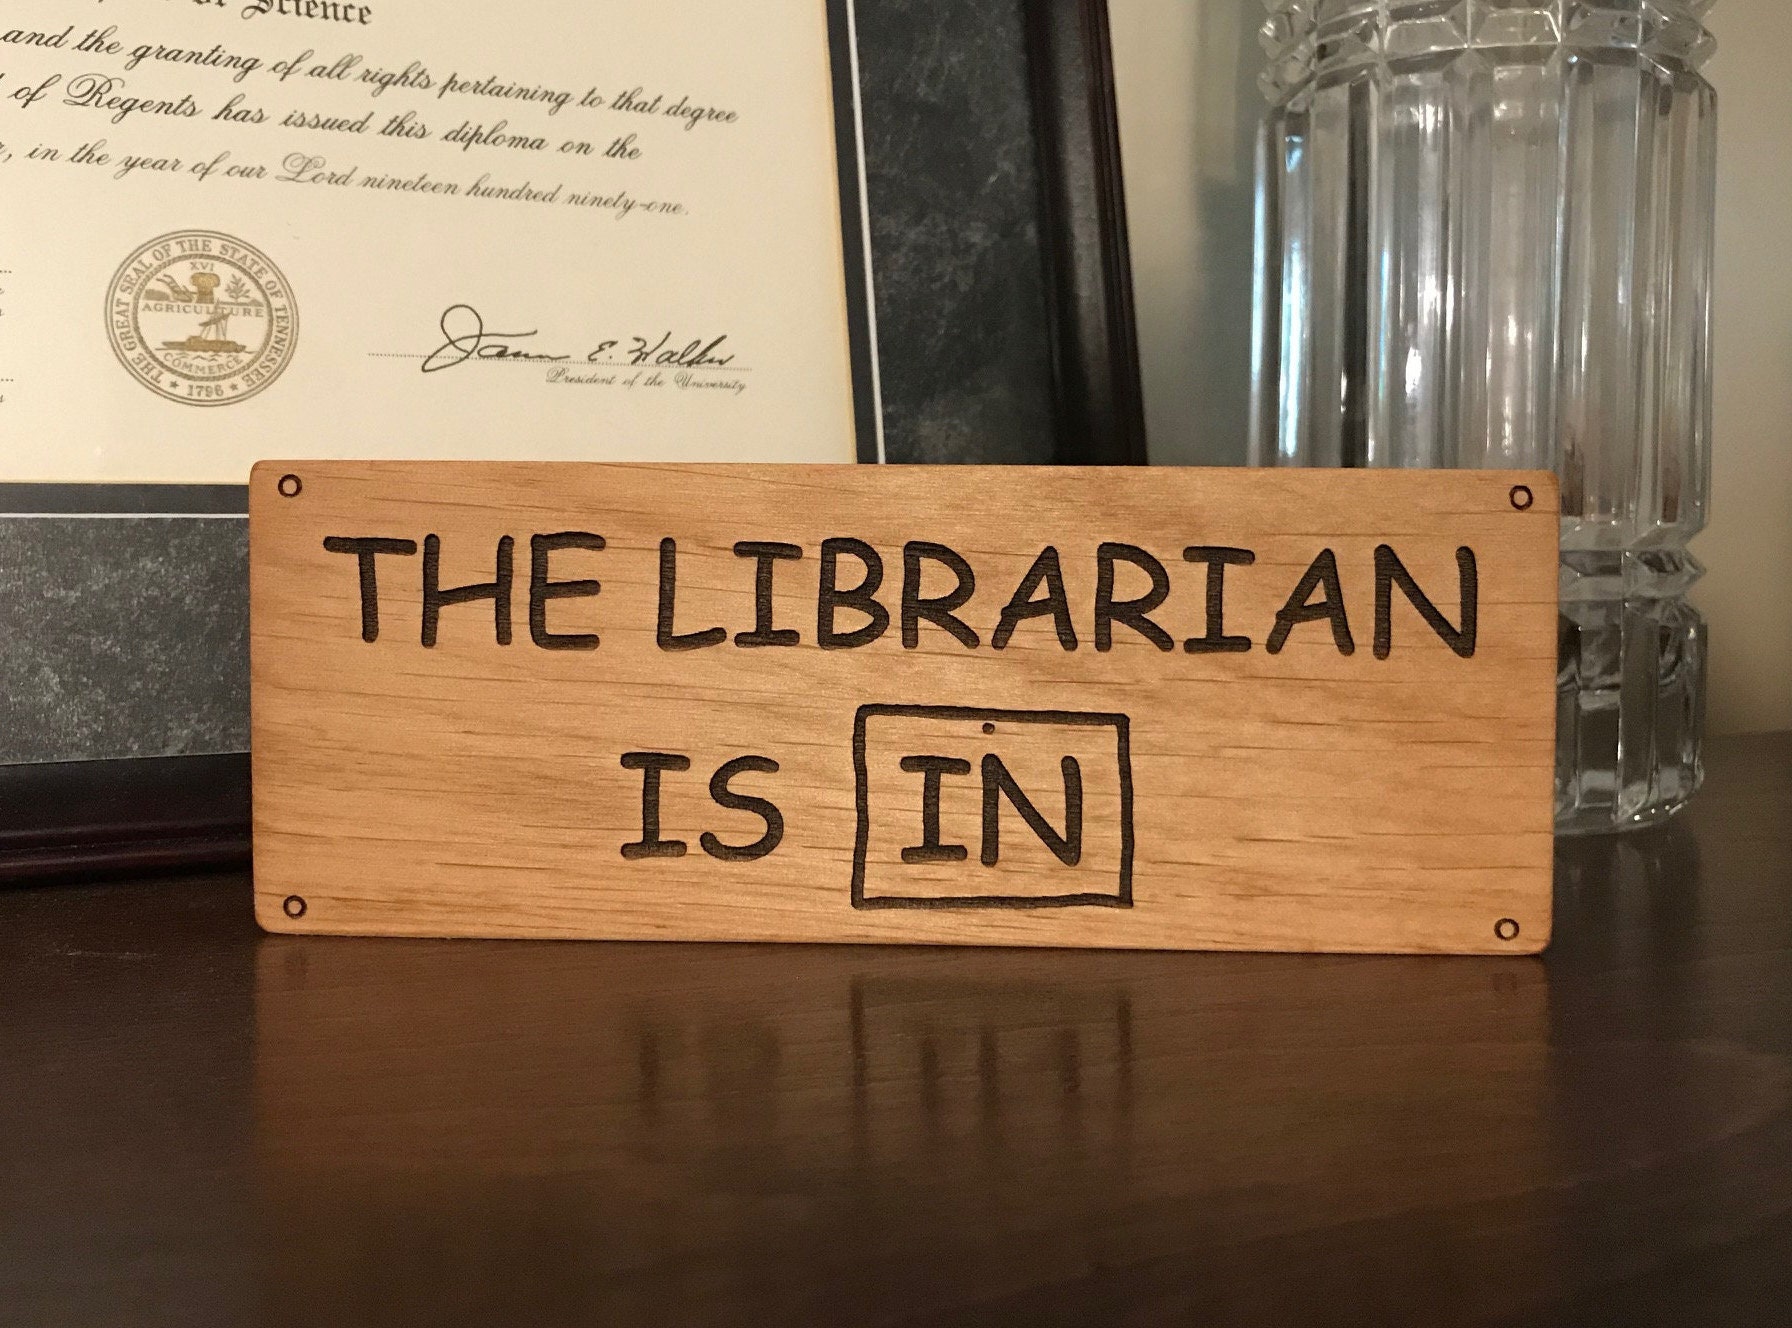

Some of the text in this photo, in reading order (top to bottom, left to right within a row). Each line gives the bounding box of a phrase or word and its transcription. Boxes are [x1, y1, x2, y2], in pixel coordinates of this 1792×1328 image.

[241, 0, 372, 25] Science
[1, 25, 740, 131] and the granting of all rights pertaining to that degree
[10, 73, 642, 161] of Regents has issued this diploma on the
[24, 143, 62, 161] in
[66, 139, 112, 166] the
[114, 155, 182, 180] year
[190, 151, 231, 181] of
[225, 163, 267, 179] our
[275, 152, 354, 187] Lord
[359, 172, 461, 196] nineteen
[464, 173, 561, 205] hundred
[566, 190, 690, 221] ninety-one.
[190, 261, 214, 272] XVI
[115, 238, 291, 388] THE GREAT SEAL OF THE STATE OF TENNESSEE
[141, 302, 265, 318] AGRICULTURE
[163, 351, 244, 375] COMMERCE
[546, 367, 747, 396] President of the University
[323, 531, 1479, 661] THE LIBRARIAN
[620, 752, 1083, 867] IS IN
